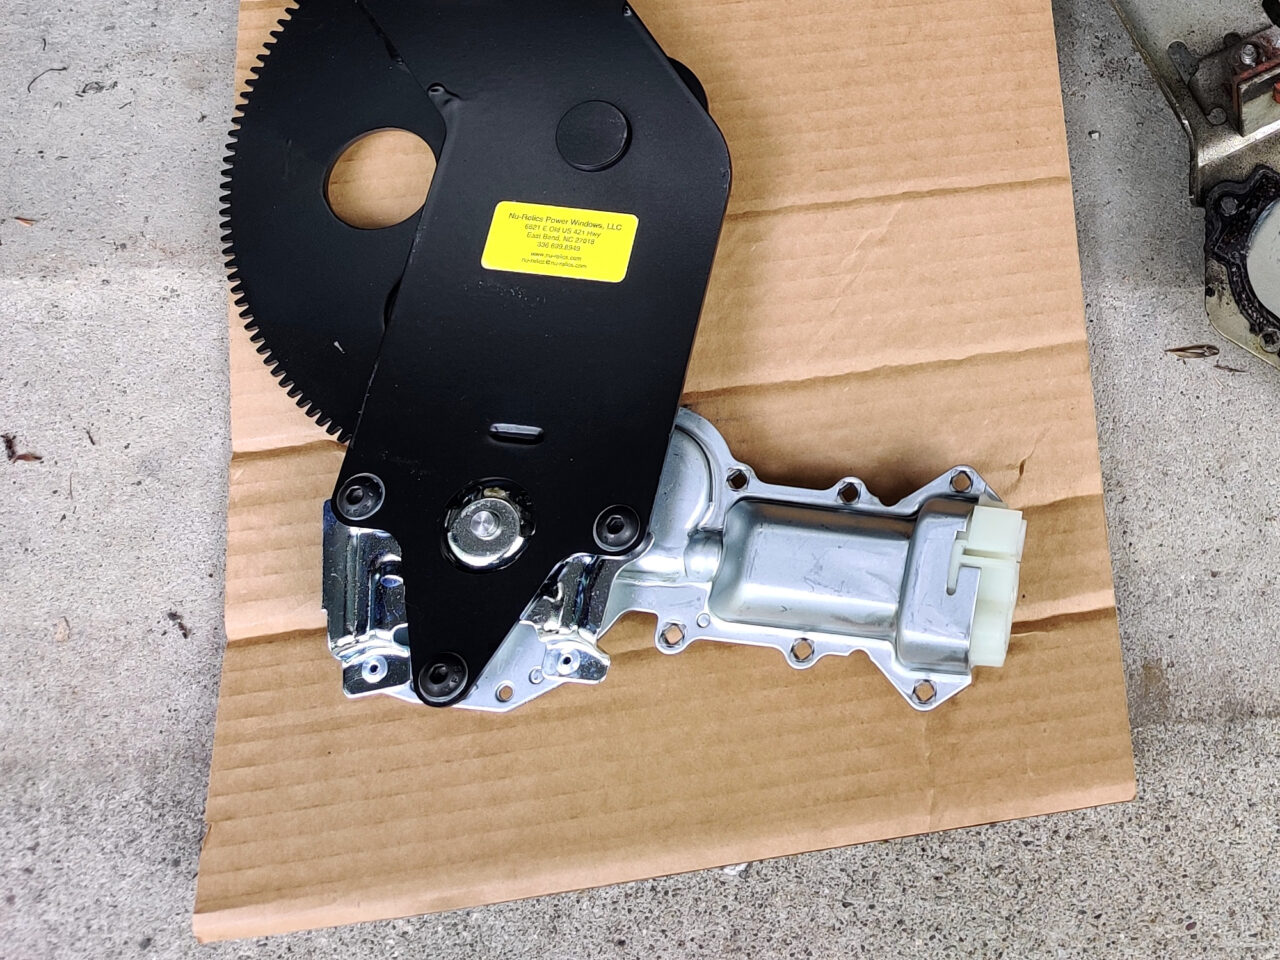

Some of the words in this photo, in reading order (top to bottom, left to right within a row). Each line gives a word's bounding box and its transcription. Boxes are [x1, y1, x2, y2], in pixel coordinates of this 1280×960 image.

[508, 212, 544, 223] Nu-Relics
[545, 216, 568, 225] Power
[570, 218, 605, 230] Windows,
[606, 223, 623, 231] LLC
[562, 226, 572, 234] US
[587, 229, 601, 238] Hwy
[563, 235, 574, 243] NC
